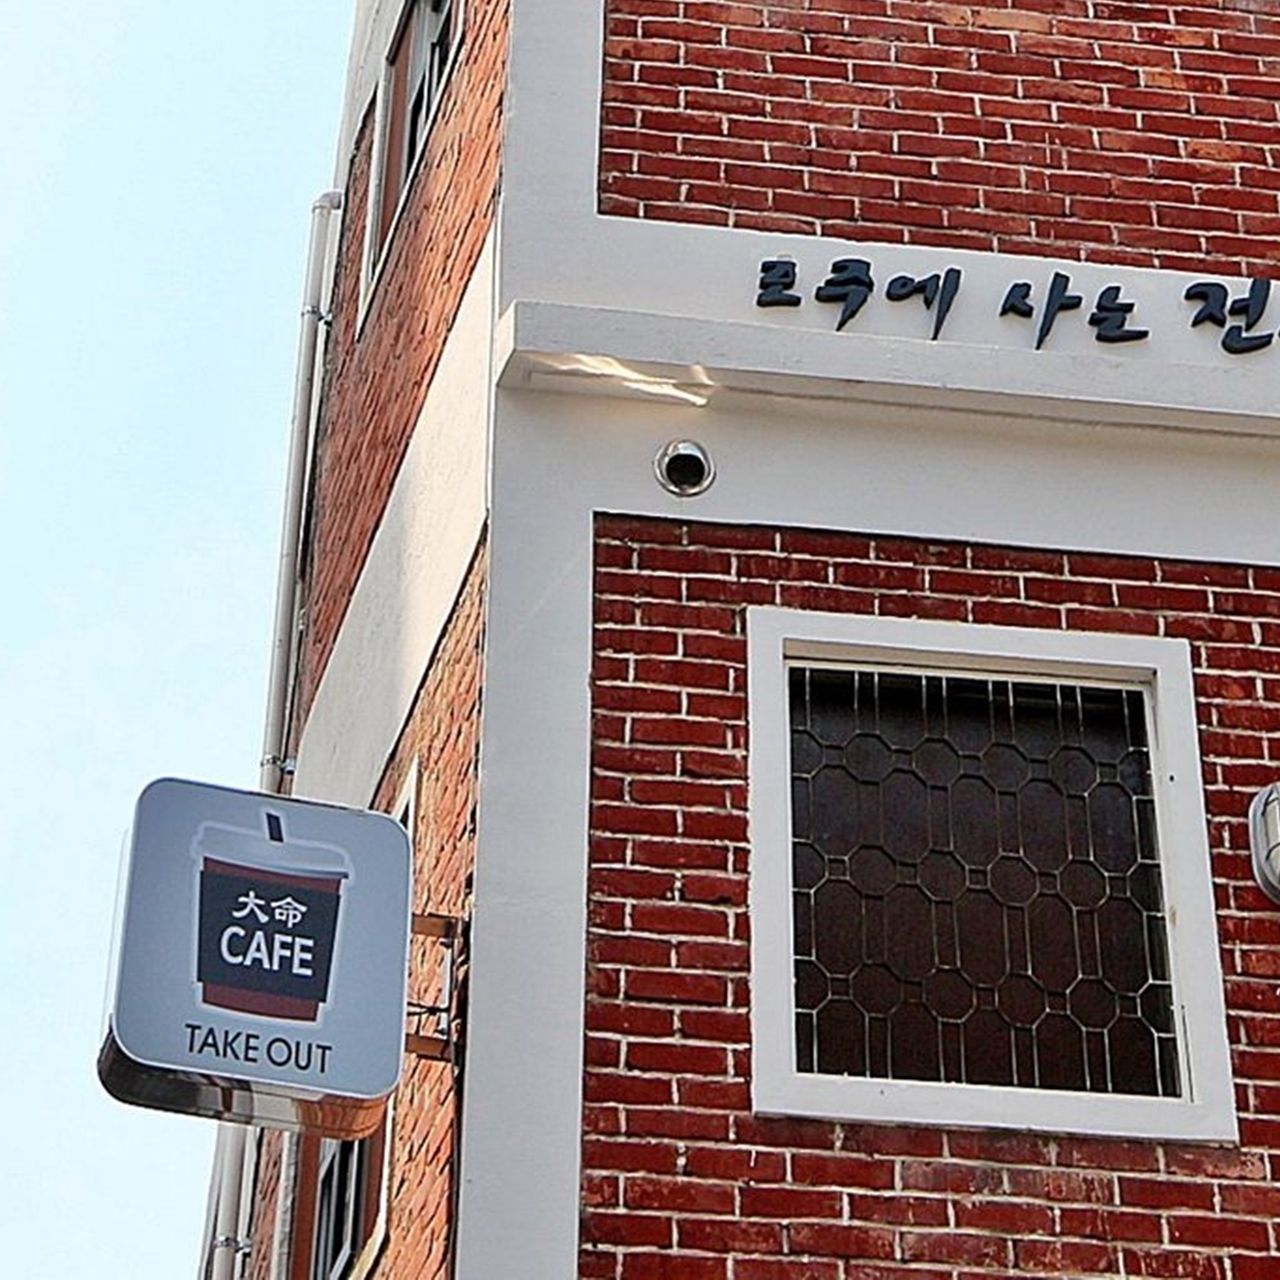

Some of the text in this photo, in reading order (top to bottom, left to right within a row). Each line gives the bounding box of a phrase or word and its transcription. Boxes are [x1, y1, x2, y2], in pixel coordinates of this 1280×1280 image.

[998, 270, 1151, 350] 사는
[231, 890, 308, 929] 大命
[220, 924, 315, 977] CAFE
[184, 1022, 333, 1074] TAKE OUT
